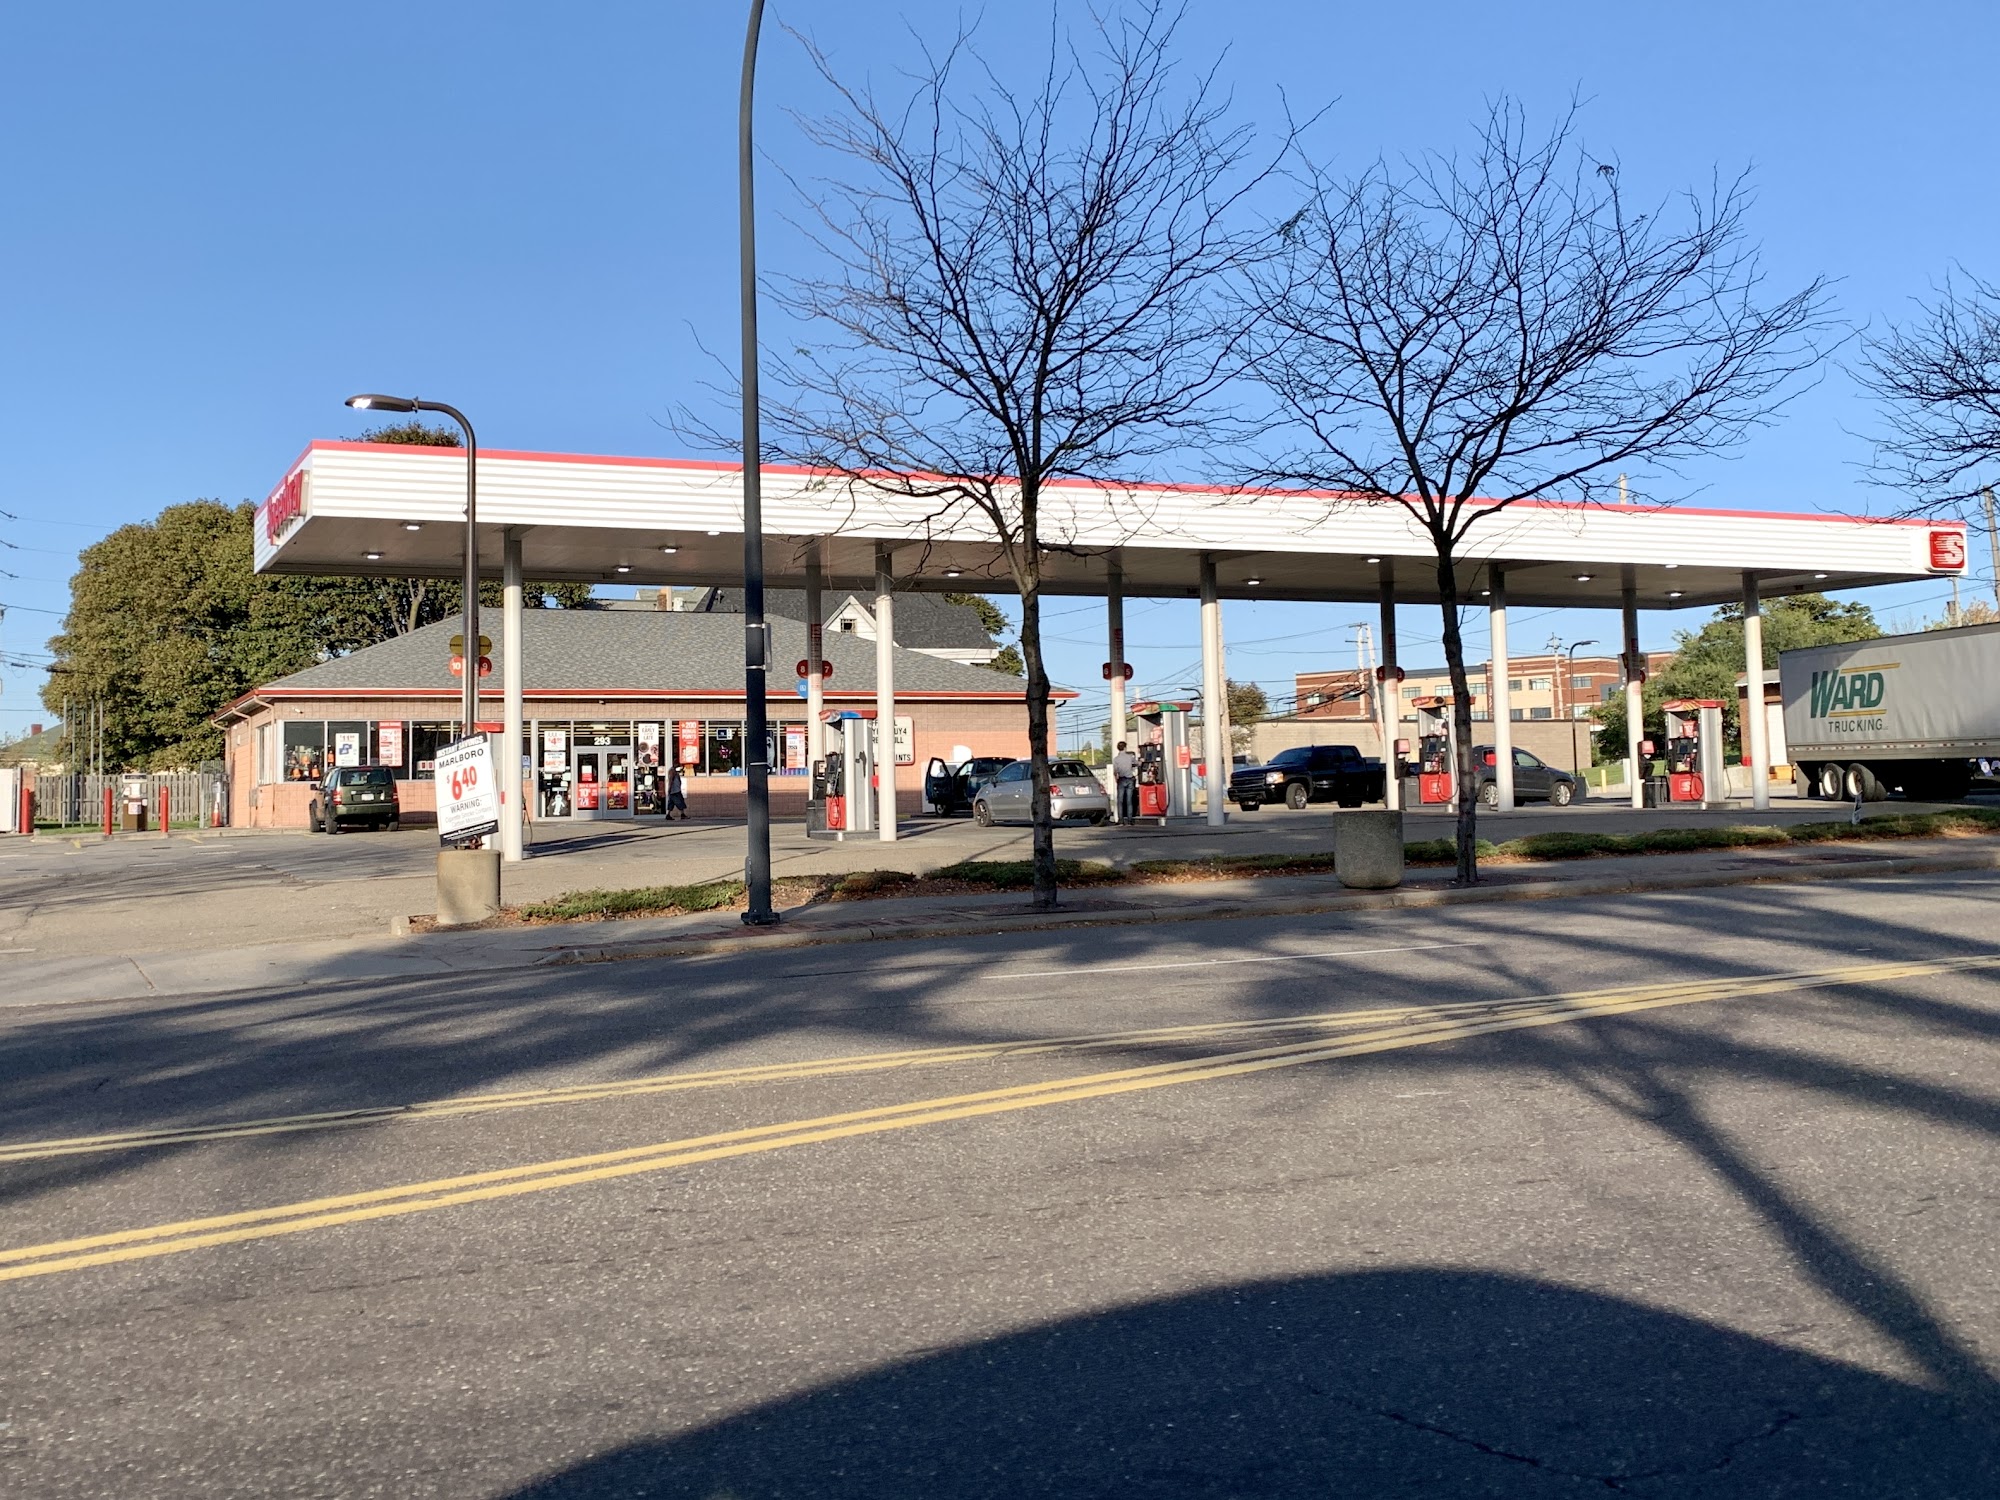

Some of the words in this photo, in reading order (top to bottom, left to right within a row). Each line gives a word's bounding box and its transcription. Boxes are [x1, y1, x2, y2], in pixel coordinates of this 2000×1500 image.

[452, 662, 461, 670] 10
[800, 665, 806, 673] 8
[1810, 669, 1885, 719] WARD
[1828, 718, 1883, 733] TRUCKING
[593, 736, 611, 746] 293
[438, 748, 484, 769] MARLBORO
[450, 798, 482, 813] WARNING:
